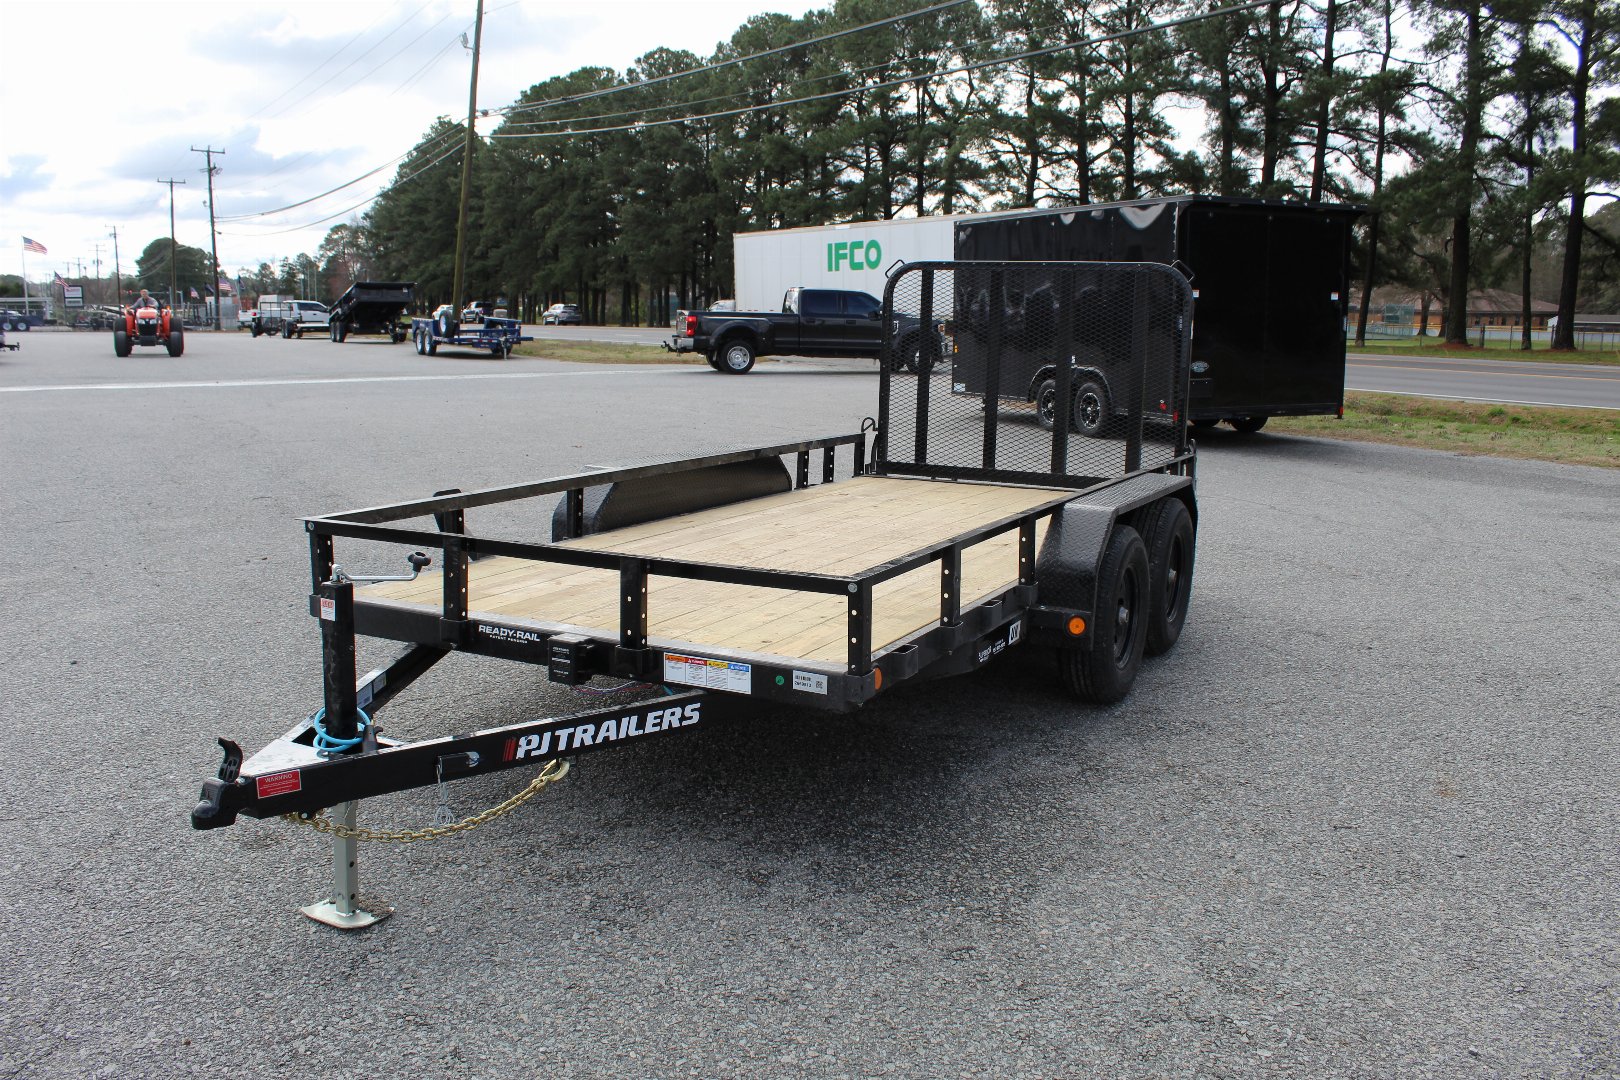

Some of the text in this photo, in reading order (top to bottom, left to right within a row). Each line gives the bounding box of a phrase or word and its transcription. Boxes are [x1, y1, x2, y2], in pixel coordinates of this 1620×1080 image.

[827, 239, 882, 272] IFCO
[478, 624, 541, 642] READY-RAIL
[515, 702, 702, 760] PJ TRAILERS
[265, 774, 293, 783] WARNING
